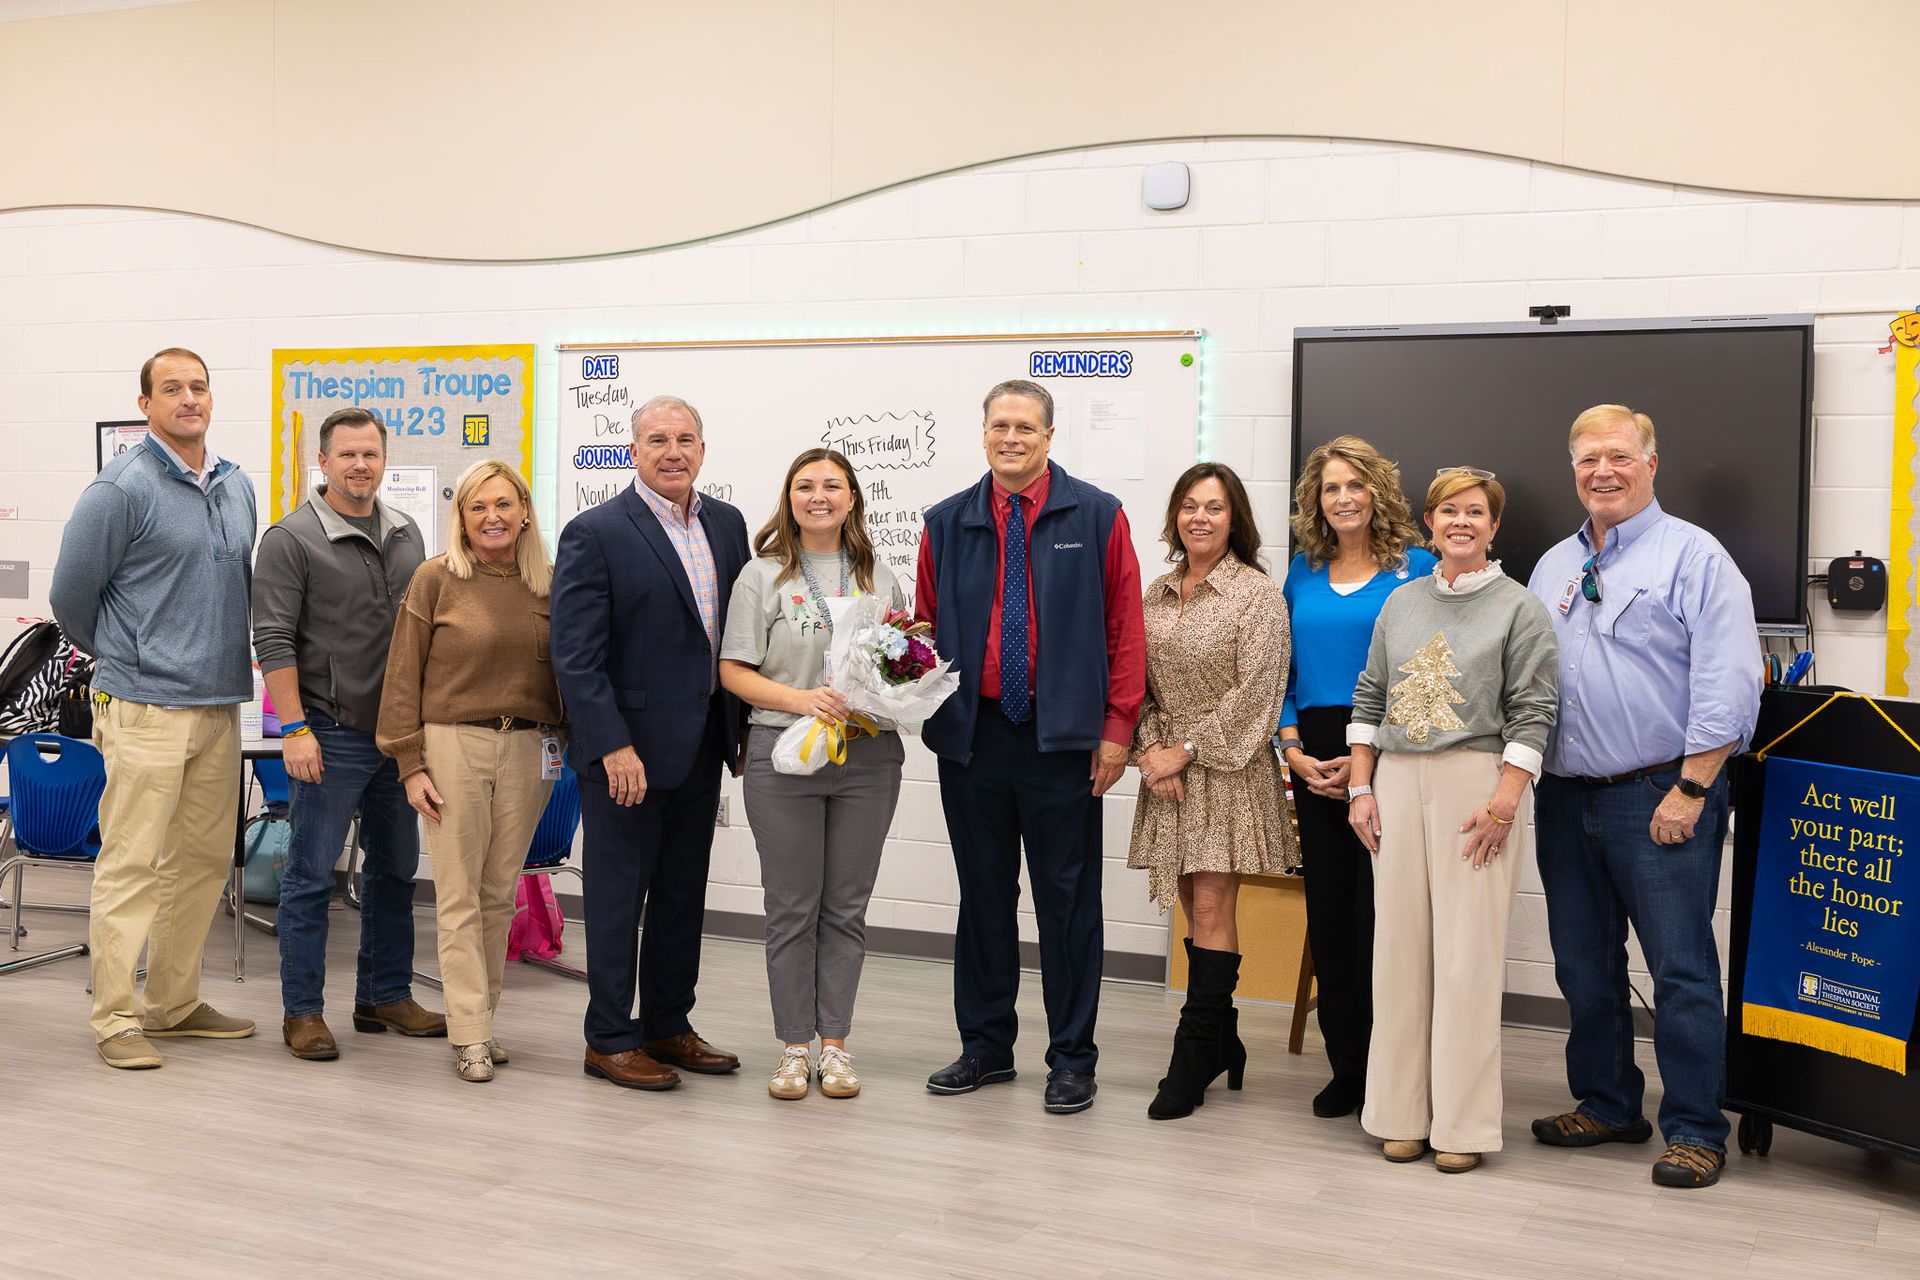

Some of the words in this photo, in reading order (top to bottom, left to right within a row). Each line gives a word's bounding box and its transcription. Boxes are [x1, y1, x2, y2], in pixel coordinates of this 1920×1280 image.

[584, 357, 618, 377] DATE
[1032, 354, 1130, 374] REMINDERS
[289, 369, 404, 406] Thespian
[417, 367, 512, 402] Troupe
[569, 384, 634, 409] Tuesday,
[593, 414, 629, 438] Dec.
[575, 447, 633, 468] JOURNA
[834, 434, 866, 458] This
[866, 480, 893, 501] 7th
[1801, 783, 1842, 811] Act
[1849, 795, 1896, 821] well
[1790, 817, 1844, 841] your
[1848, 827, 1904, 857] part;
[1800, 843, 1858, 876] there
[1864, 857, 1892, 883] all
[1789, 872, 1825, 899] the
[1830, 878, 1903, 916] honor
[1822, 906, 1859, 937] lies
[1806, 941, 1848, 960] Alexander
[1851, 952, 1875, 967] Pope
[1822, 982, 1880, 1005] INTERNATIONAL
[1822, 991, 1851, 1005] THESPIAN
[1851, 1000, 1880, 1012] SOCIETY
